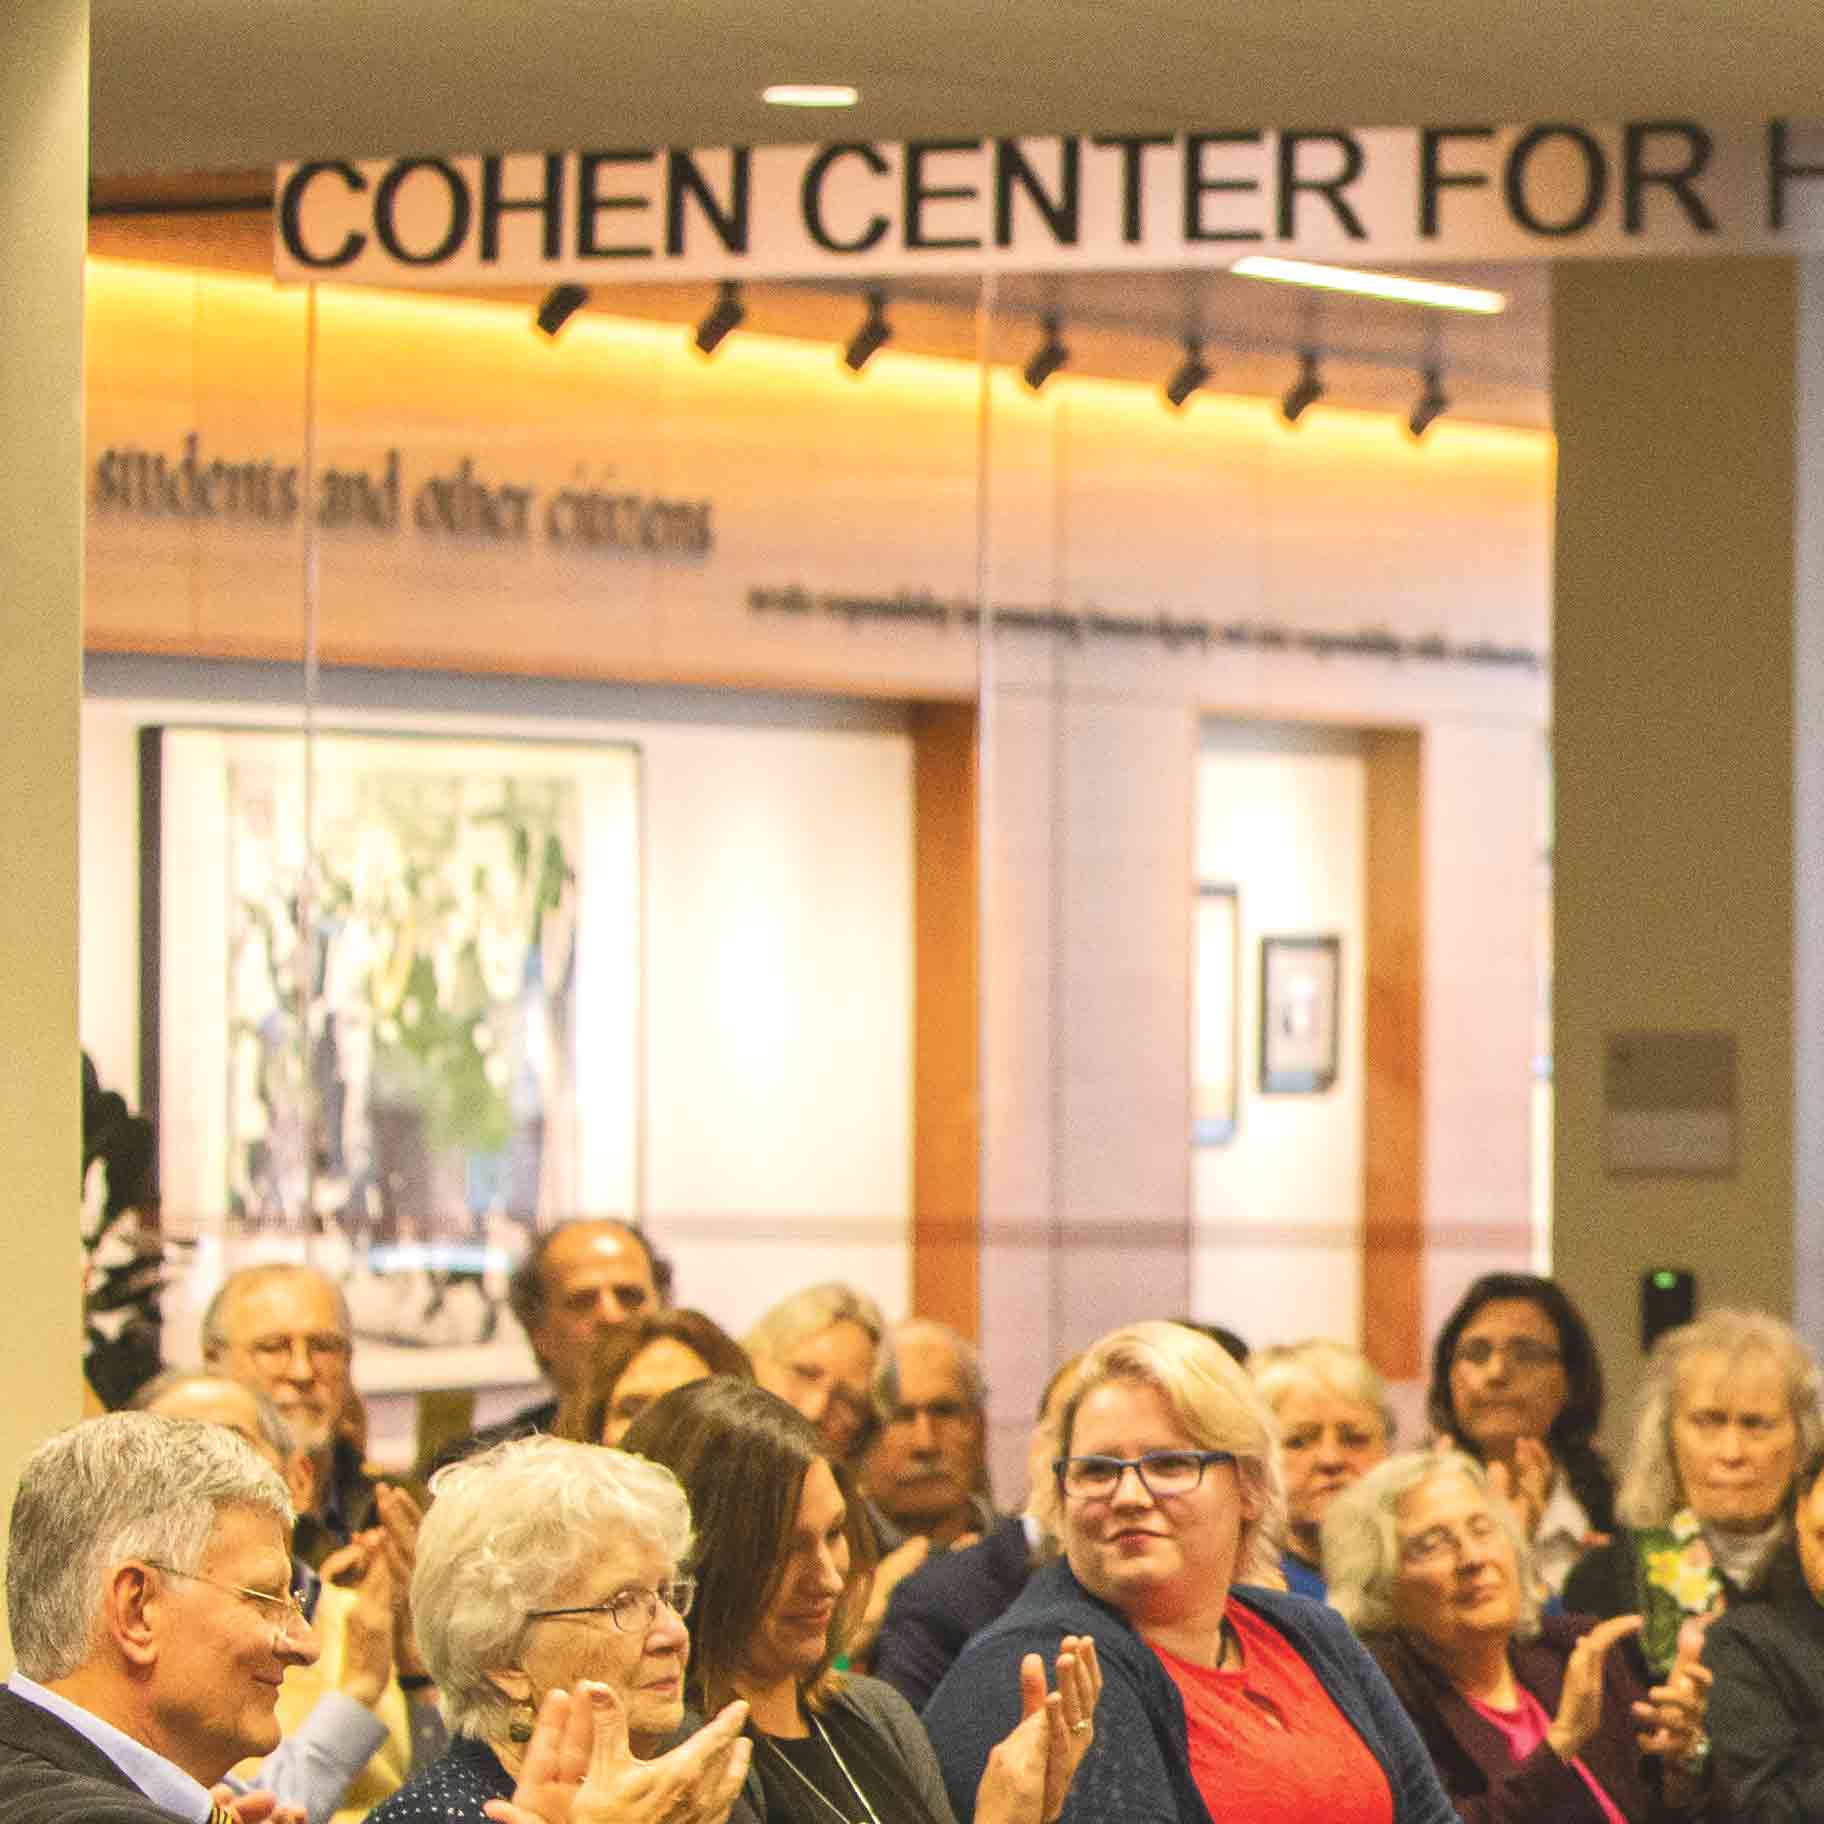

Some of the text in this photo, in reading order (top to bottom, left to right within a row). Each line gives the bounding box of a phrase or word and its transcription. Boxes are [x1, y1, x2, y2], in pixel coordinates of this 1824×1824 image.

[280, 144, 750, 269] COHEN
[801, 128, 1369, 254] CENTER
[1418, 119, 1719, 241] FOR
